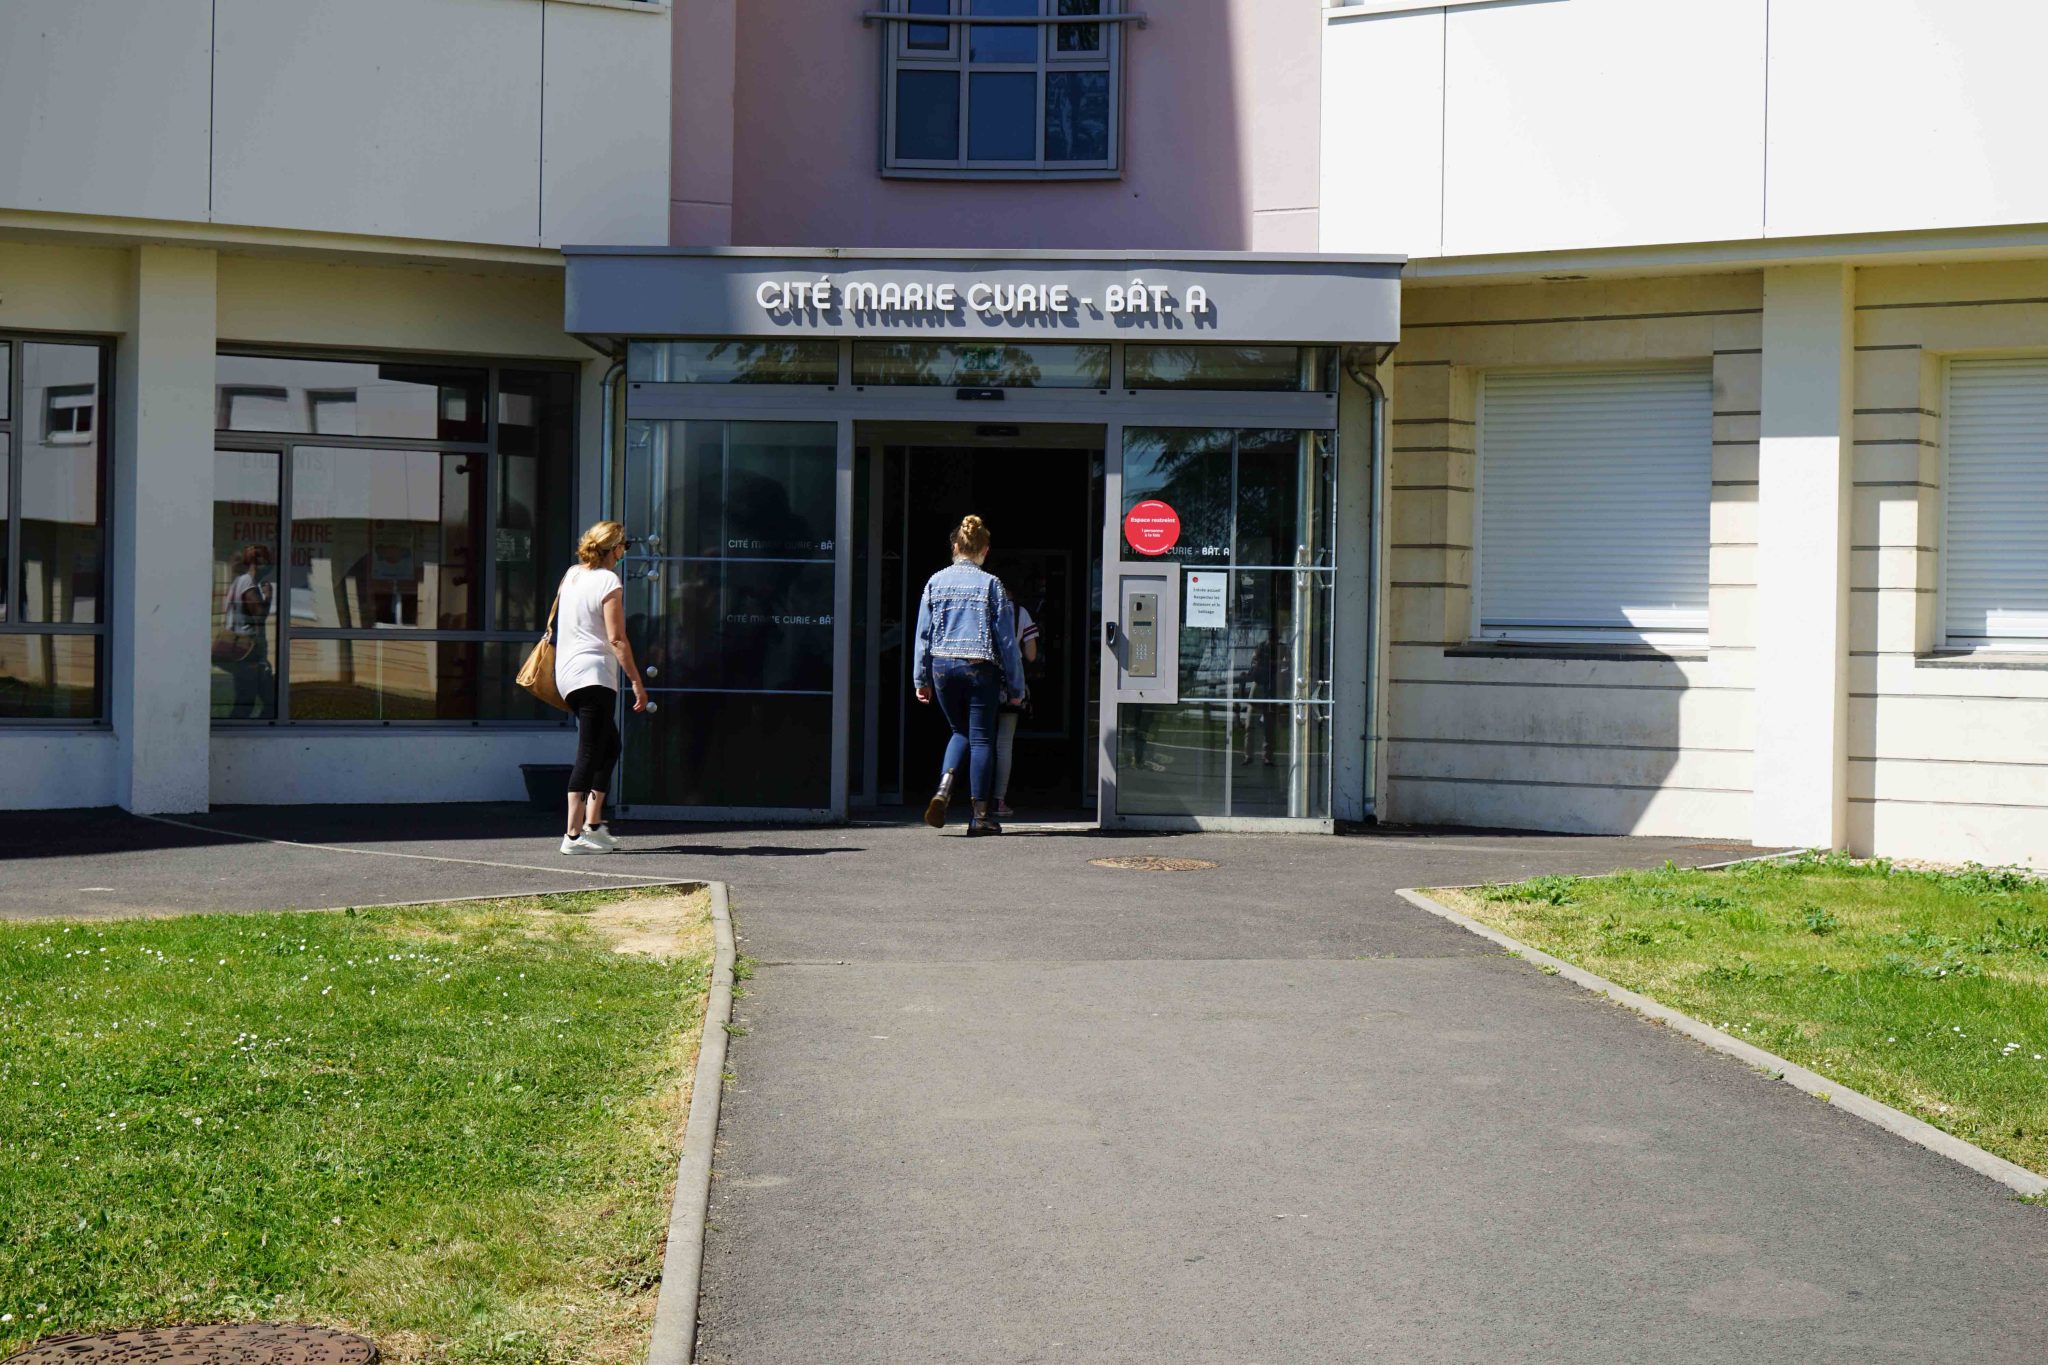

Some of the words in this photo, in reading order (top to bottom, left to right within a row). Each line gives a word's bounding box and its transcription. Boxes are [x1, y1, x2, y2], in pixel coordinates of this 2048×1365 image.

[756, 275, 831, 309] CITÉ
[844, 282, 955, 312] MARIE
[967, 282, 1068, 313] CURIE
[1105, 277, 1172, 313] BÂT.
[1185, 284, 1207, 314] A
[233, 521, 277, 541] FAITE
[728, 539, 749, 549] CITÉ
[820, 540, 835, 551] BÂ
[1201, 545, 1221, 556] BÂT.
[1223, 547, 1230, 556] A
[782, 615, 811, 625] CURIE
[819, 614, 834, 625] BÂ
